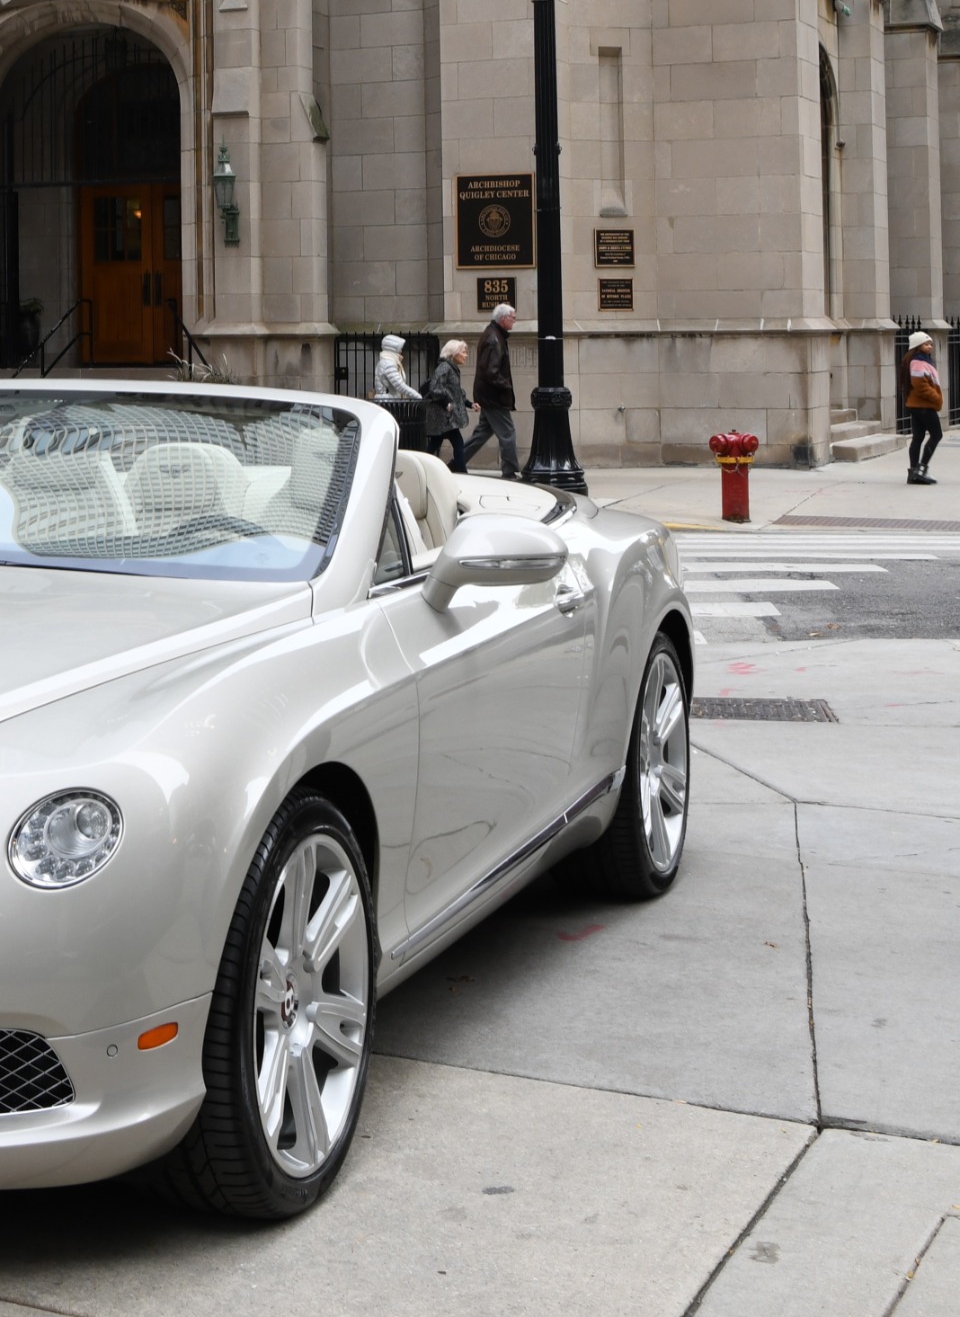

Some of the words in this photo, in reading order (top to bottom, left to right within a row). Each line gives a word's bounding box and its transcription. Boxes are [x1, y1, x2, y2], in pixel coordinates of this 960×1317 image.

[468, 179, 520, 189] ARCHBISHOP
[460, 190, 495, 200] QUIGLEY
[496, 189, 530, 198] CENTER
[470, 244, 520, 252] ARCHDIOCESE
[474, 253, 483, 261] OF
[484, 252, 516, 260] CHICAGO
[484, 279, 509, 293] 835
